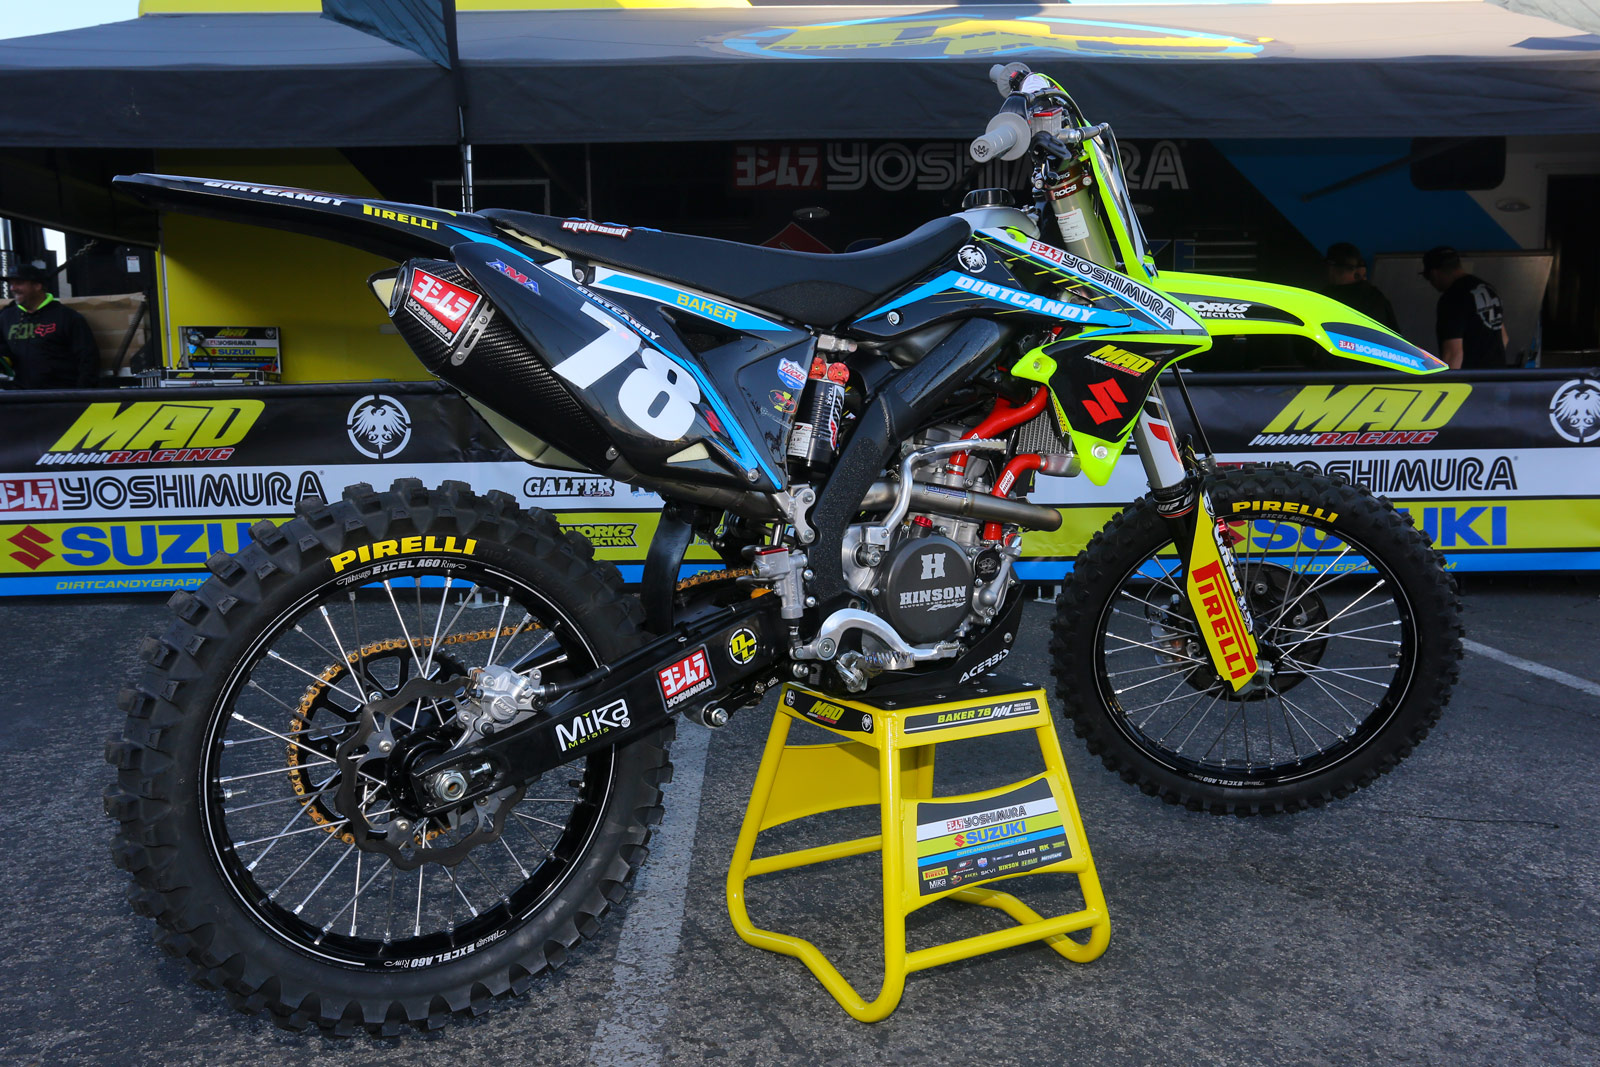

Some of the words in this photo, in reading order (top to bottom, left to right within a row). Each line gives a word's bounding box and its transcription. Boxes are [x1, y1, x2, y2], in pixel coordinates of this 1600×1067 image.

[203, 181, 349, 206] DIRTCANDY
[363, 204, 438, 231] PIRELLI
[486, 258, 541, 296] AMA
[1061, 253, 1175, 325] YOSHIMURA
[676, 294, 738, 322] BAKER
[954, 276, 1097, 321] DIRTCANDY
[408, 298, 454, 340] YOSHIMURA
[576, 286, 661, 340] DIRTCANDY
[1198, 311, 1247, 319] NECTION
[1089, 344, 1155, 373] MAD
[1355, 344, 1419, 368] YOSHIMURA
[552, 301, 701, 441] 78
[782, 365, 805, 381] LUCAS
[1261, 383, 1473, 434] MAD
[48, 399, 266, 452] MAD
[1314, 431, 1439, 446] RACING
[104, 447, 235, 464] RACING
[59, 470, 329, 510] YOSHIMURA
[523, 477, 615, 497] GALFER
[1232, 500, 1339, 523] PIRELLI
[61, 522, 254, 566] SUZU
[330, 535, 477, 573] PIRELLI
[373, 561, 415, 575] EXCEL
[417, 559, 440, 568] A60
[441, 560, 460, 569] Rim
[921, 552, 946, 580] H
[56, 578, 208, 590] DIRTCANDYGRAPH
[900, 585, 966, 605] HINSON
[1192, 560, 1257, 679] PIRELLI
[959, 649, 1010, 684] ACERBIS
[666, 678, 713, 708] YOSHIMURA
[809, 700, 845, 720] MAD
[937, 710, 975, 723] BAKER
[977, 708, 992, 717] 78
[568, 726, 610, 749] Metals
[964, 805, 1027, 828] YOSHIMURA
[966, 820, 1027, 845] SUZUKI
[390, 959, 411, 968] Rim
[410, 956, 434, 968] A60
[436, 943, 475, 964] EXCEL
